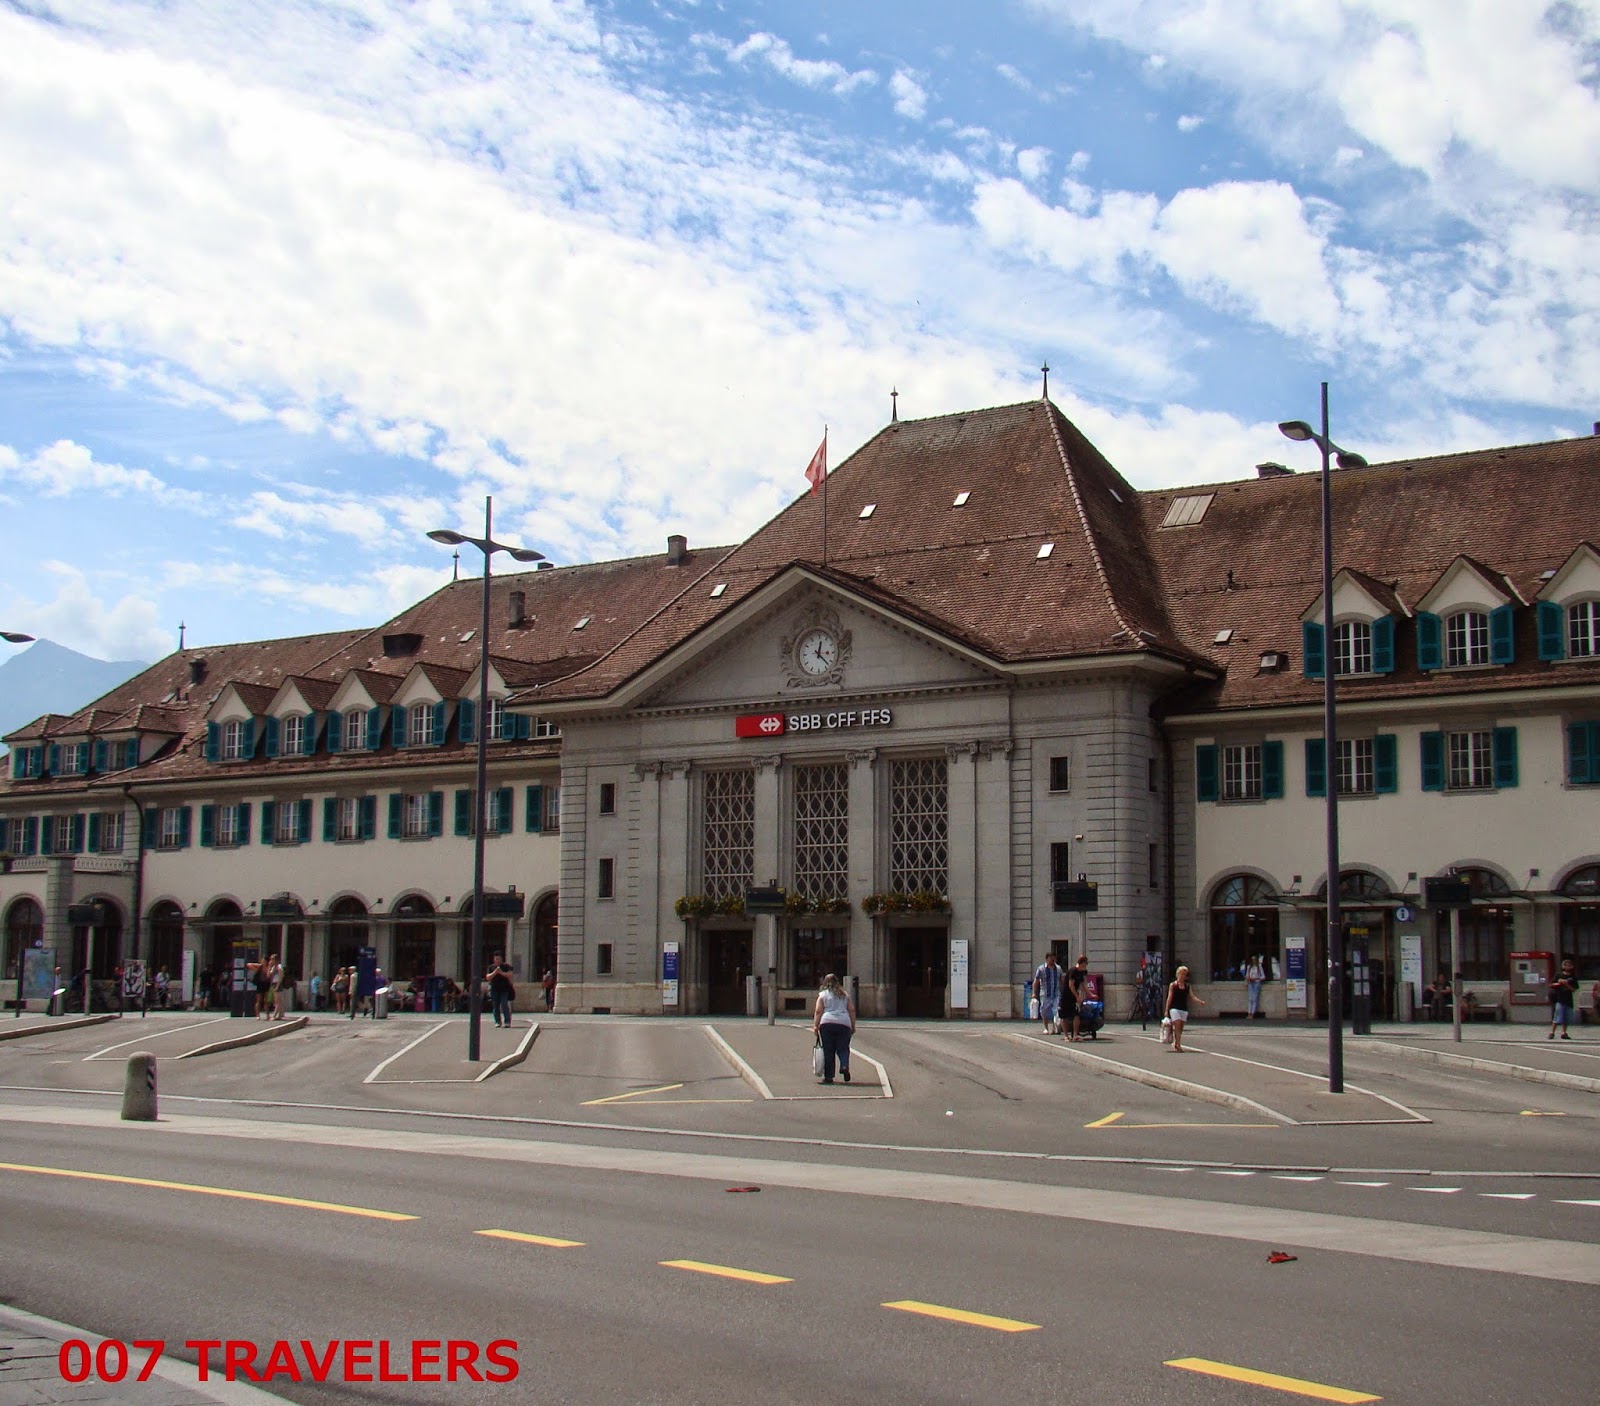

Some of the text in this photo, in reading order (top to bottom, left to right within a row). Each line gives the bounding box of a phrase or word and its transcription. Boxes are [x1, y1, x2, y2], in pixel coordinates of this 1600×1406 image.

[789, 708, 891, 731] SBB CFF FFS
